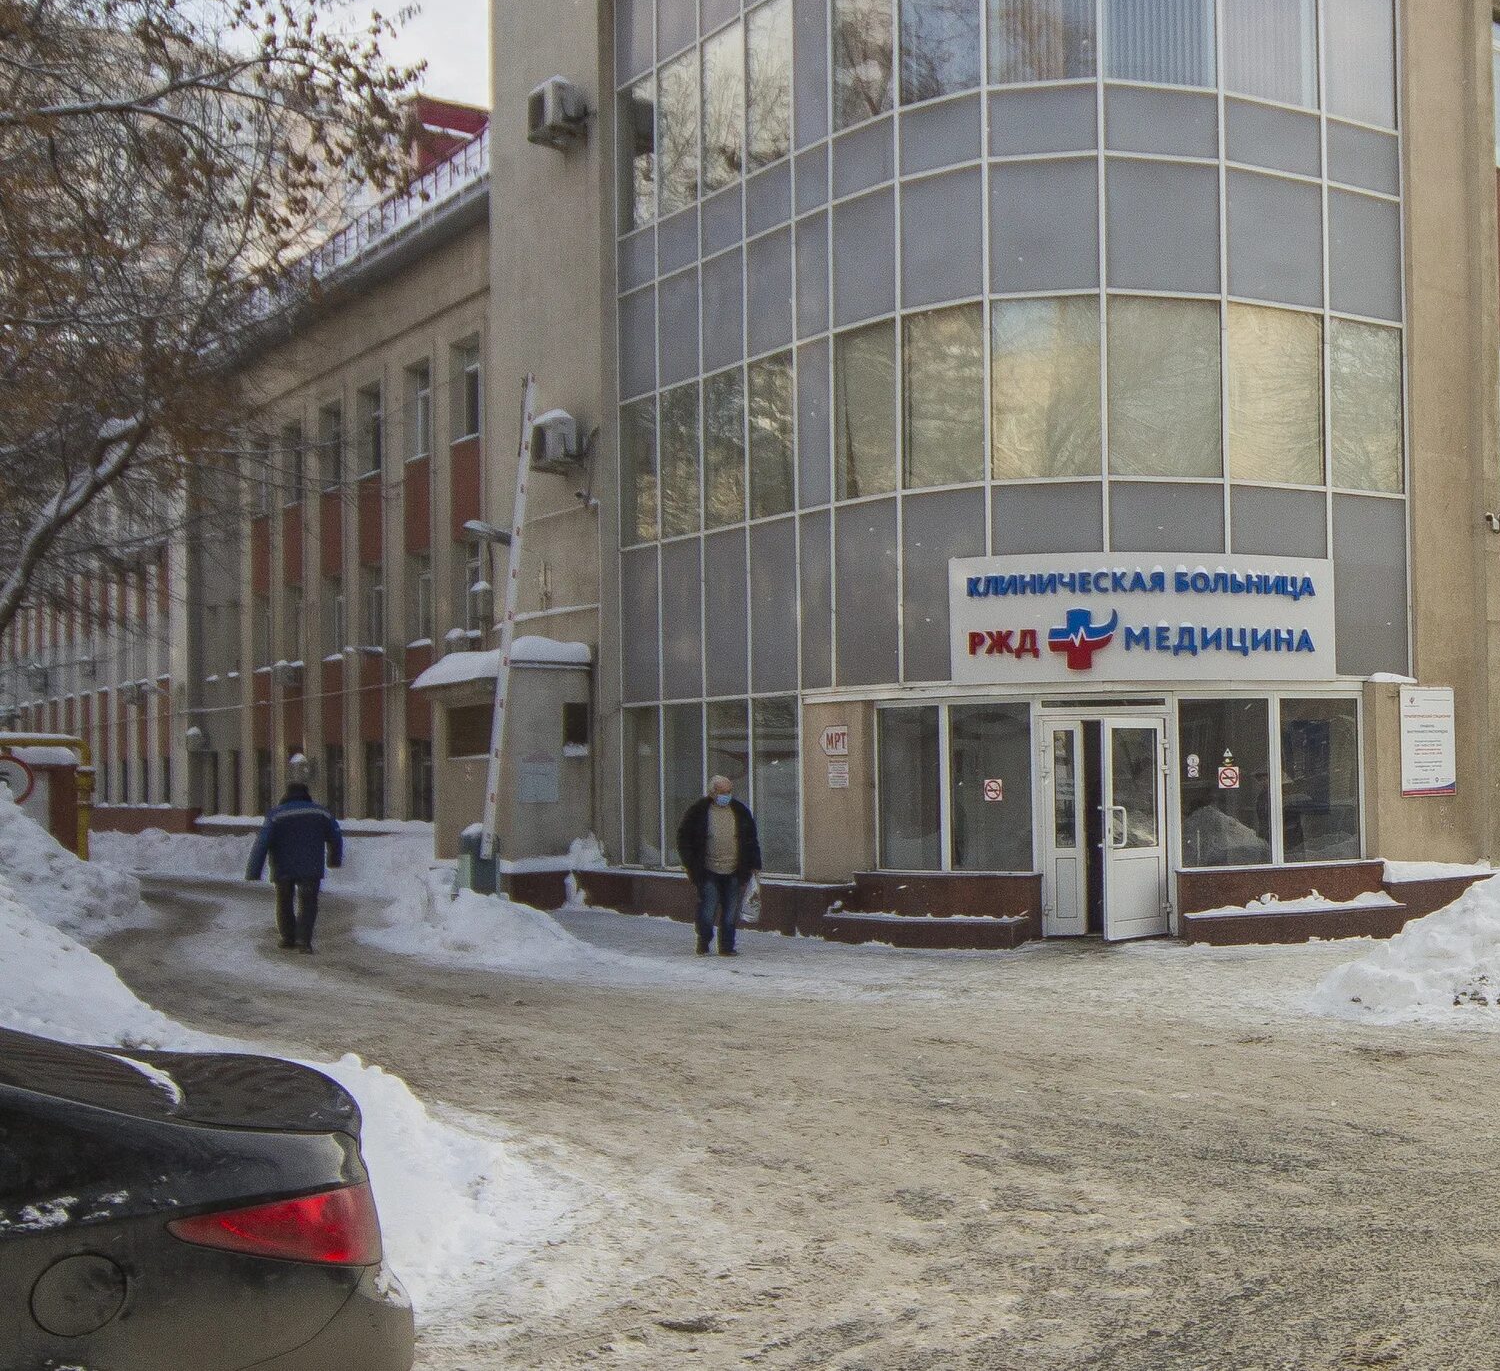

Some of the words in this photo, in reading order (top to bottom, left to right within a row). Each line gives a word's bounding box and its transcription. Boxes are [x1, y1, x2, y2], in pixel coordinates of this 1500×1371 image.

[966, 571, 1165, 597] КЛИНИЧЕСКАЯ
[1174, 570, 1316, 600] БОЛЬНИЦА
[968, 628, 1040, 659] РЖД
[1124, 625, 1316, 657] МЕДИЦИНА
[826, 732, 847, 749] МРТ
